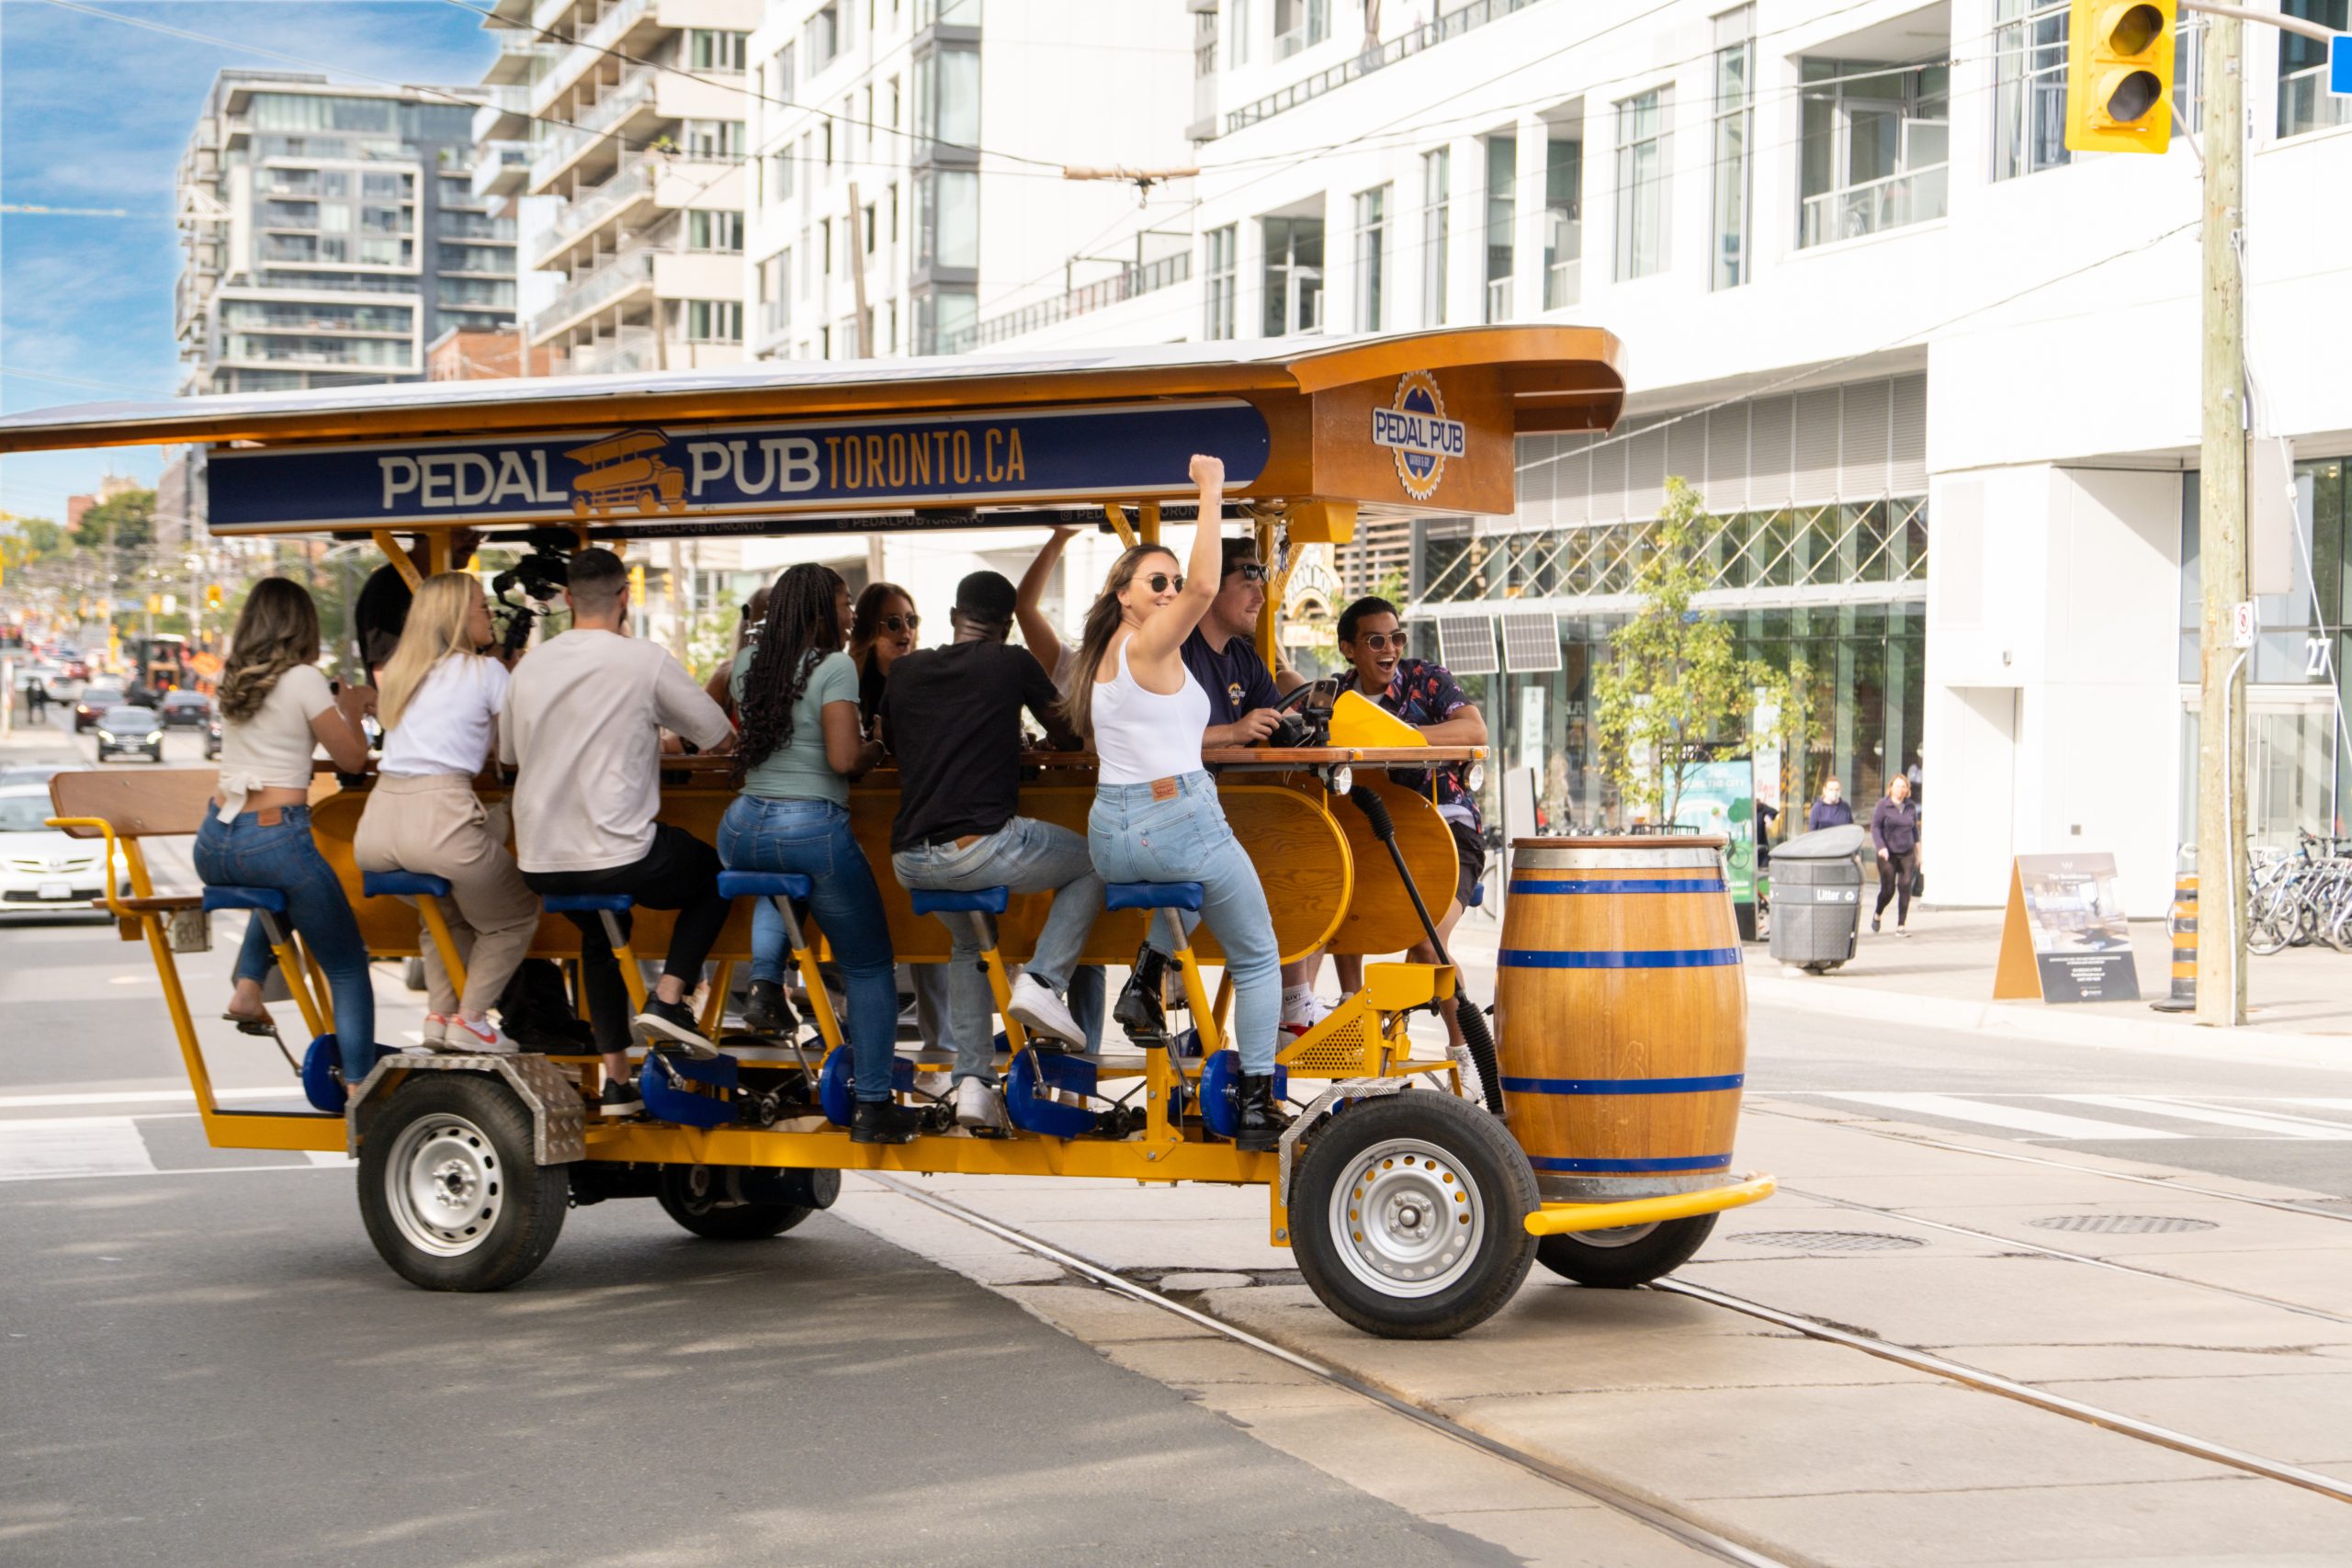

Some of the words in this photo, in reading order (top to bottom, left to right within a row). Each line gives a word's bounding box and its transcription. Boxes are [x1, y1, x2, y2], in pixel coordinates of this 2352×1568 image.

[1375, 411, 1428, 447] PEDAL
[1430, 420, 1464, 453] PUB
[378, 449, 569, 509] PEDAL
[687, 437, 820, 497] PUB
[825, 427, 1025, 490] TORONTO.CA
[2305, 637, 2333, 676] 27
[1816, 888, 1840, 901] Litter
